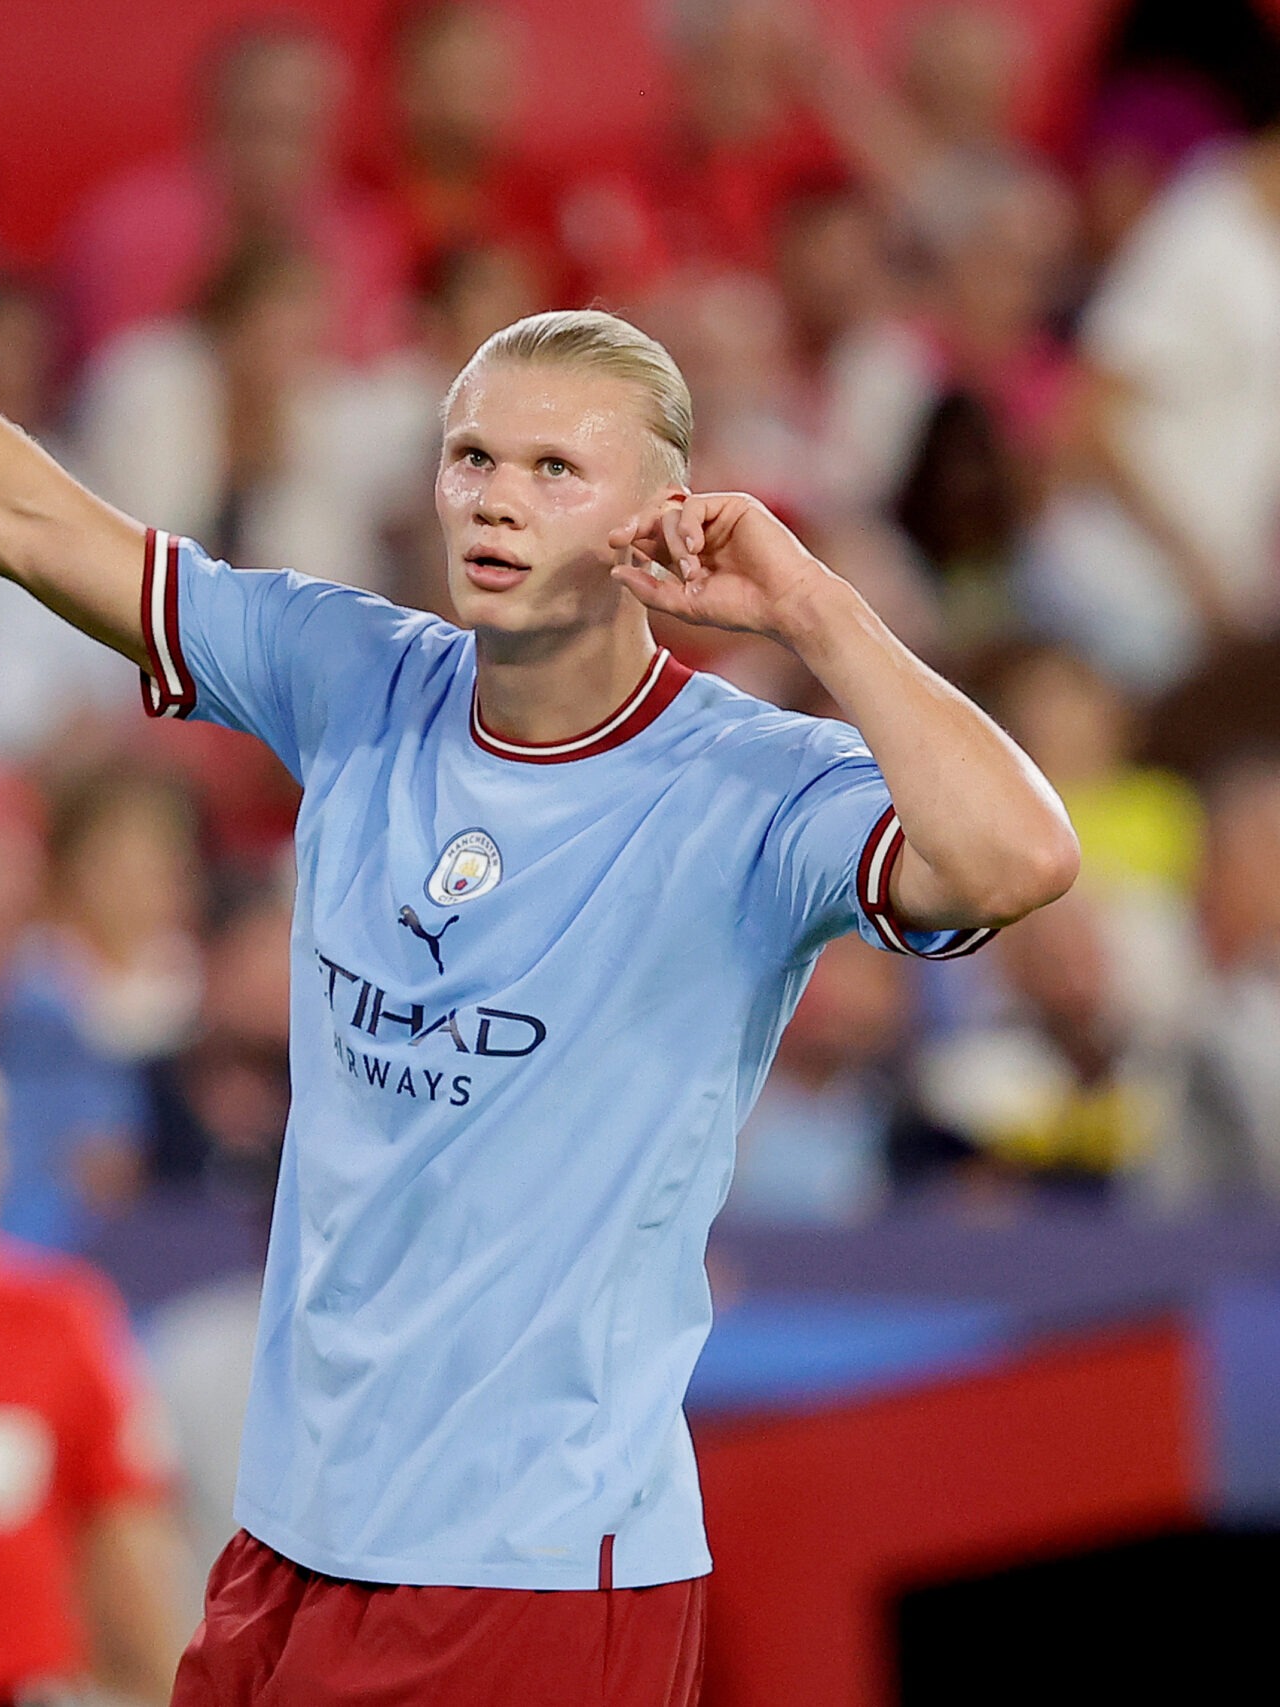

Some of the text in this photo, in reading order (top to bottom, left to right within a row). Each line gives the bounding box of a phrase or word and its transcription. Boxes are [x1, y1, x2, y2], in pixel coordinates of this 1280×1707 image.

[448, 834, 499, 867] MANCHESTER
[437, 894, 460, 904] CITY
[315, 949, 547, 1058] TIHAD
